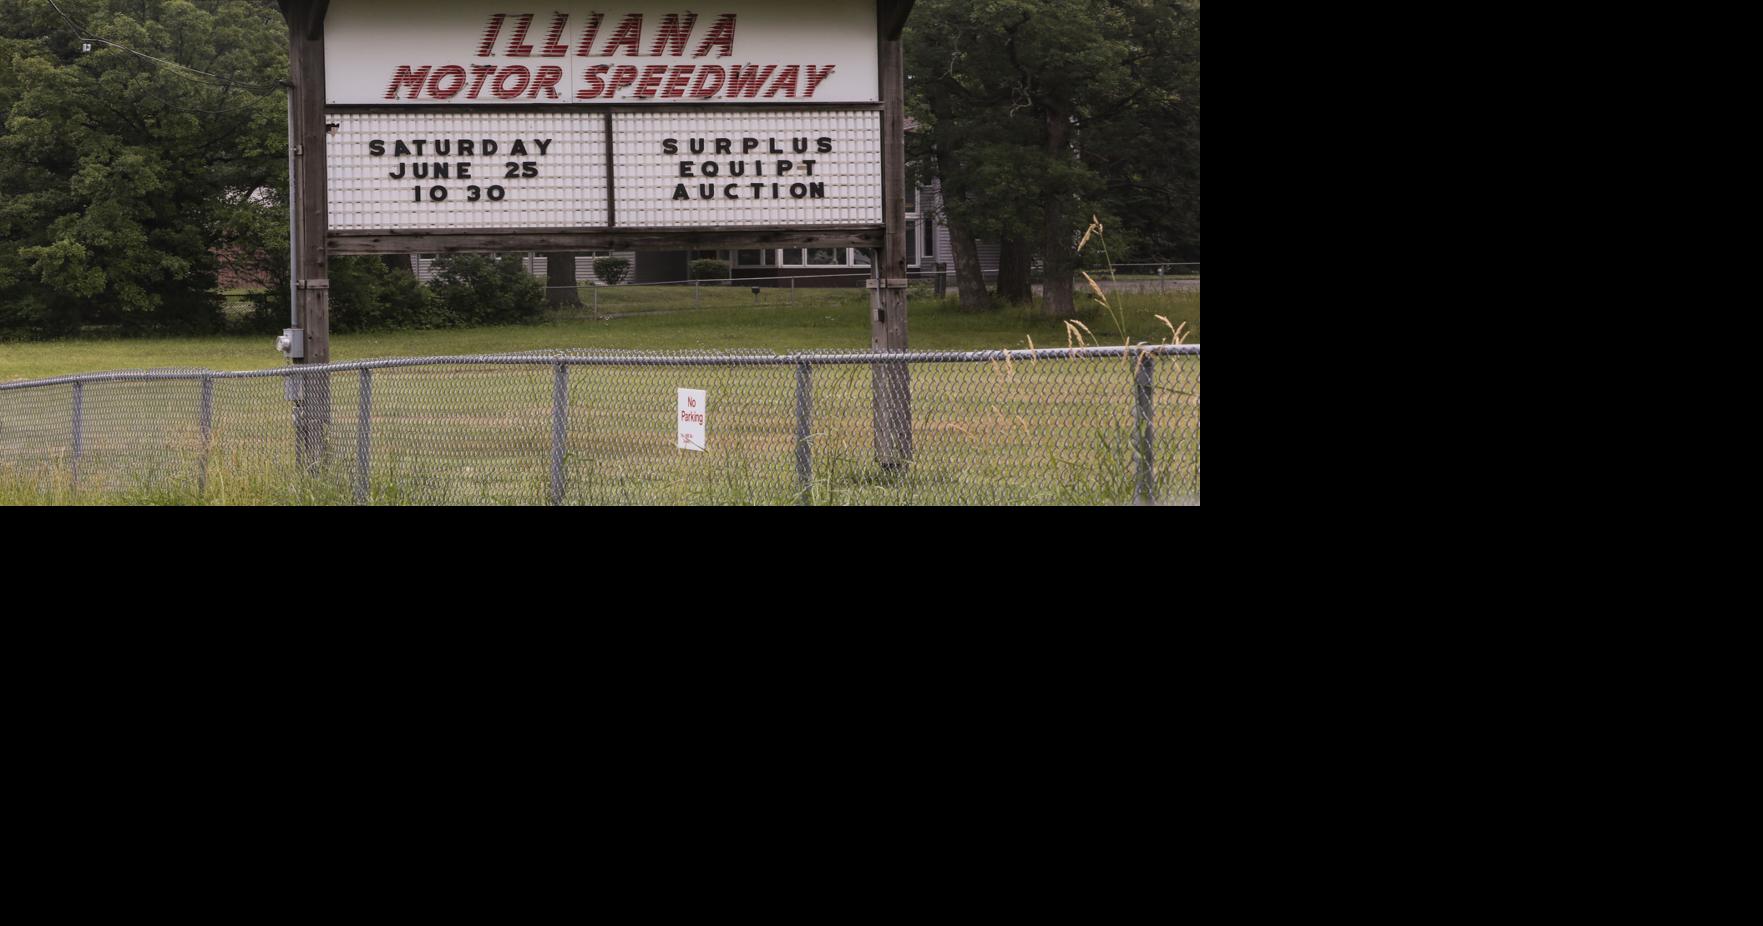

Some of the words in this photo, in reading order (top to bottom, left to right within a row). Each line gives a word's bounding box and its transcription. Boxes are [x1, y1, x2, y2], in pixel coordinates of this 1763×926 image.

[477, 13, 737, 57] ILLIANA
[384, 65, 563, 99] MOTOR
[576, 64, 836, 99] SPEEDWAY
[369, 138, 552, 156] SATURDAY
[662, 137, 832, 155] SURPLUS
[389, 161, 472, 179] JUNE
[505, 161, 539, 178] 25
[680, 160, 816, 177] EQUIPT
[414, 185, 448, 202] 10
[467, 185, 505, 201] 30
[672, 182, 825, 200] AUCTION
[687, 396, 697, 408] No
[681, 410, 704, 426] Parking
